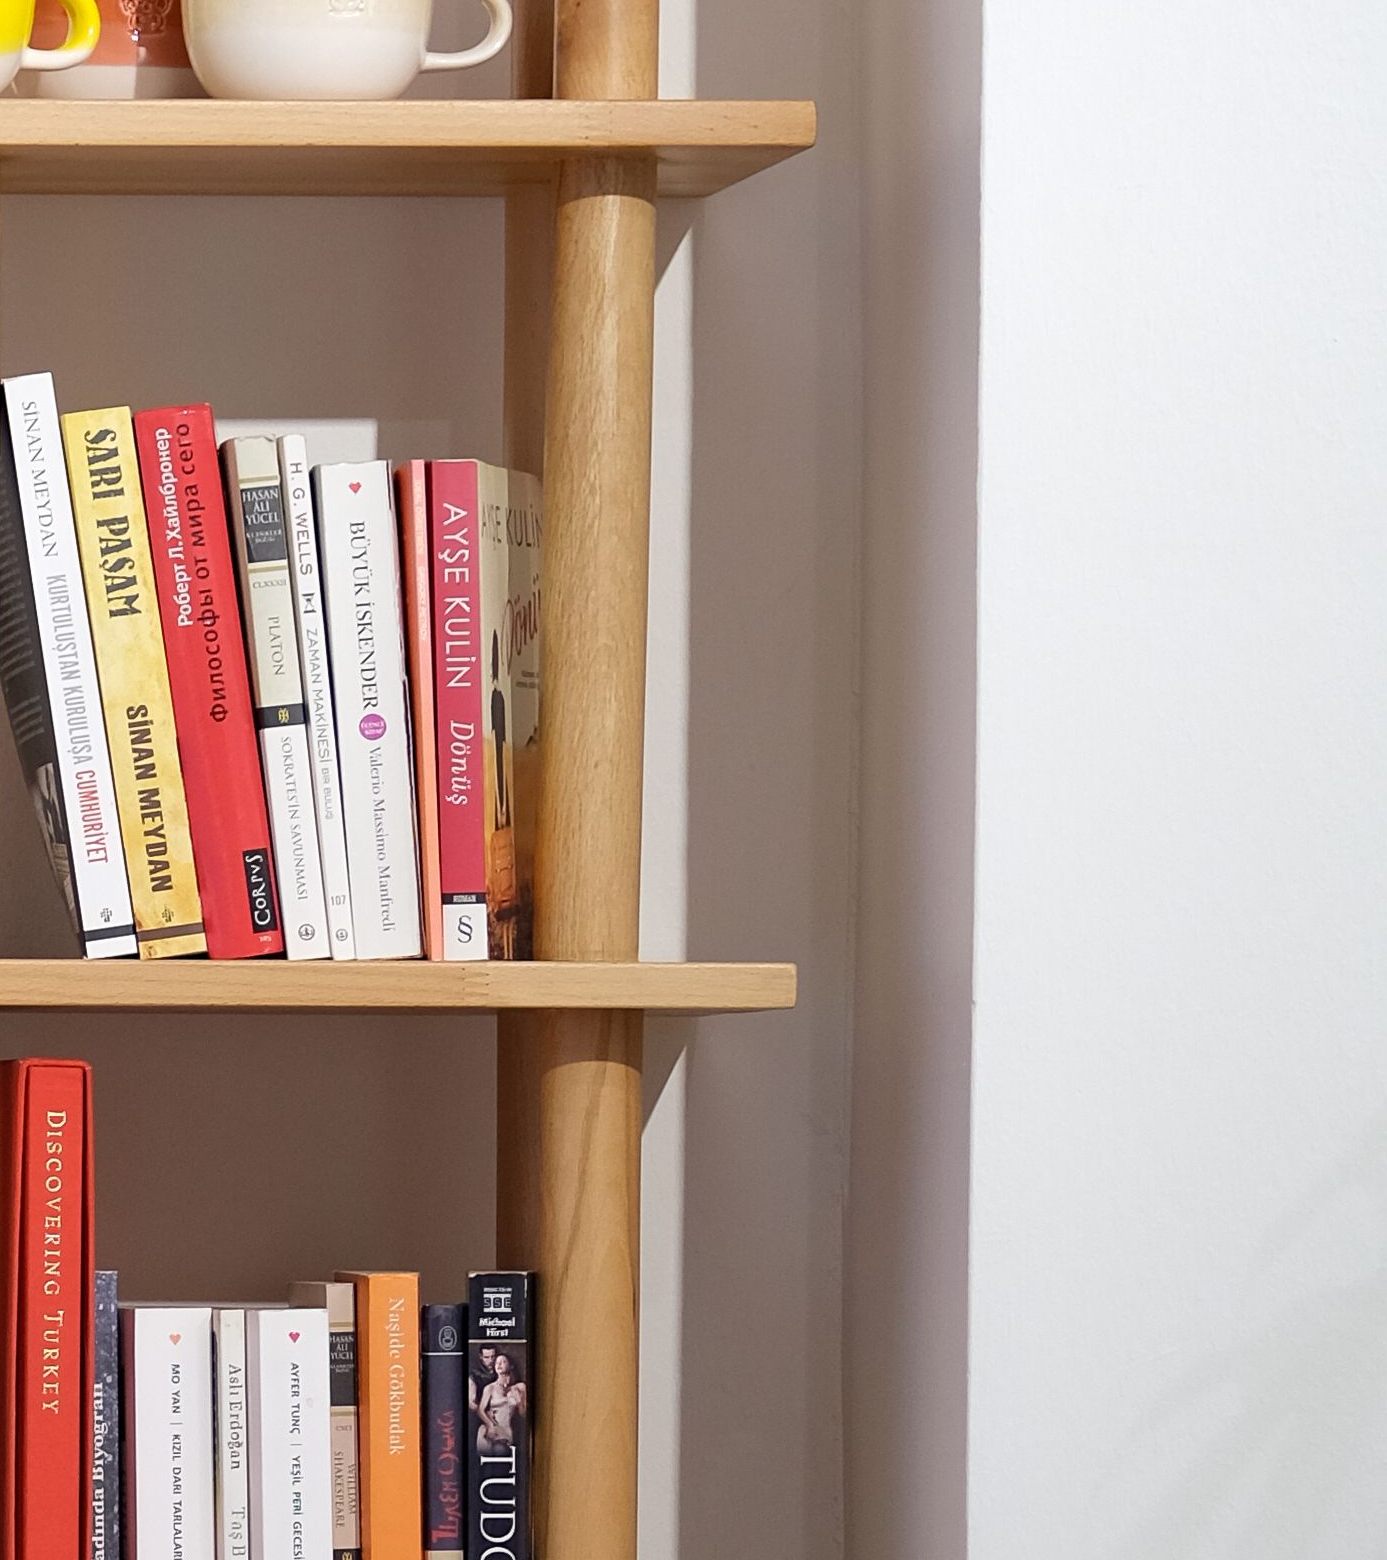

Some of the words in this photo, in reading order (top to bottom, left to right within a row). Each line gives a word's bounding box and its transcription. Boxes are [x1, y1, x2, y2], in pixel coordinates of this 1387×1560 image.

[84, 428, 126, 501] SARI
[176, 423, 196, 476] сего
[184, 483, 206, 547] мира
[242, 488, 278, 502] HASAN
[96, 515, 142, 619] PAŞAM
[193, 556, 210, 580] от
[349, 521, 372, 598] BÜYÜK
[438, 502, 470, 586] AYŞE
[196, 588, 229, 723] Философы
[354, 601, 380, 711] İSKENDER
[444, 596, 477, 689] KULİN
[126, 704, 158, 782] SİNAN
[367, 745, 383, 795] Valerio
[446, 718, 476, 806] Dönüş
[137, 787, 173, 893] MEYDAN
[372, 797, 387, 862] Massimo
[378, 865, 396, 933] Manfredi
[43, 1110, 67, 1296] DISCOVERING
[384, 1297, 406, 1360] Naşide
[42, 1310, 66, 1414] TURKEY
[170, 1364, 181, 1385] MO
[228, 1363, 243, 1396] Aslı
[290, 1361, 301, 1398] AYFER
[171, 1389, 182, 1414] YAN
[290, 1402, 301, 1435] TUNÇ
[388, 1363, 406, 1456] Gökbudak
[171, 1433, 182, 1463] KIZIL
[229, 1399, 244, 1471] Erdoğan
[172, 1467, 183, 1495] DARI
[291, 1454, 302, 1487] YEŞİL
[334, 1450, 345, 1529] SHAKESPEARE
[230, 1506, 246, 1542] Taş
[292, 1491, 303, 1516] PERİ
[293, 1520, 306, 1560] GECESİ
